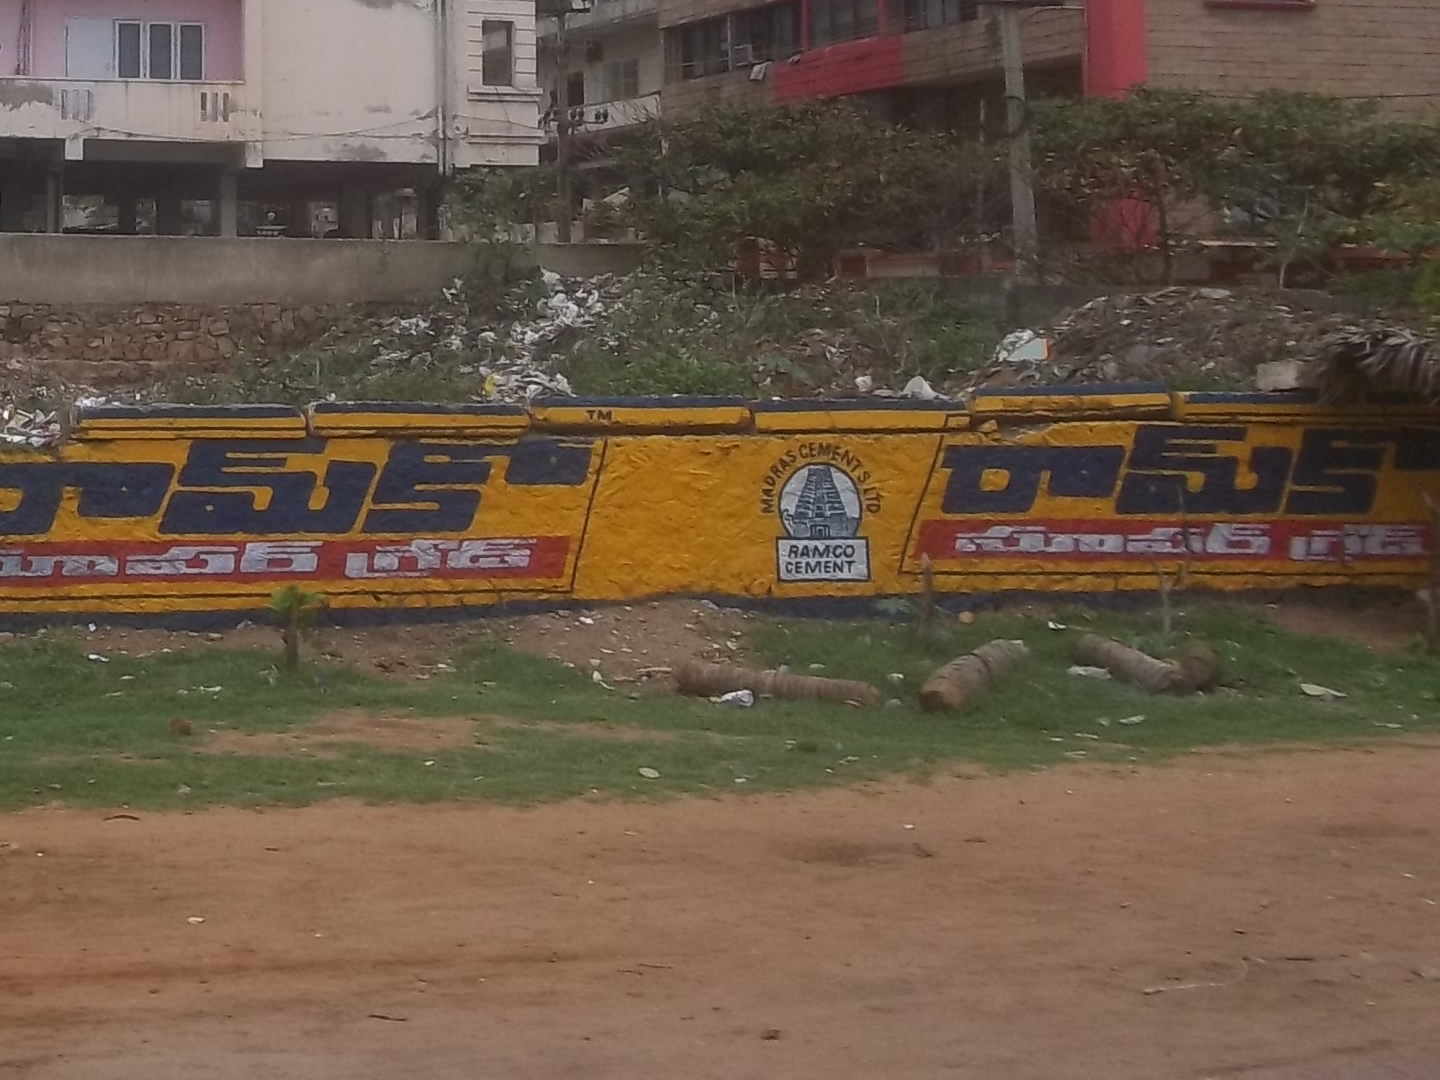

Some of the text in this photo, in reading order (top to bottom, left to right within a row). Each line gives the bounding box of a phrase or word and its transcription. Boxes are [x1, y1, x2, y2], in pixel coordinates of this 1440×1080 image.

[586, 409, 612, 420] TM
[761, 442, 883, 515] MADRAS CEMENTS LTD
[787, 544, 856, 559] RAMCO
[785, 561, 857, 574] CEMENT
